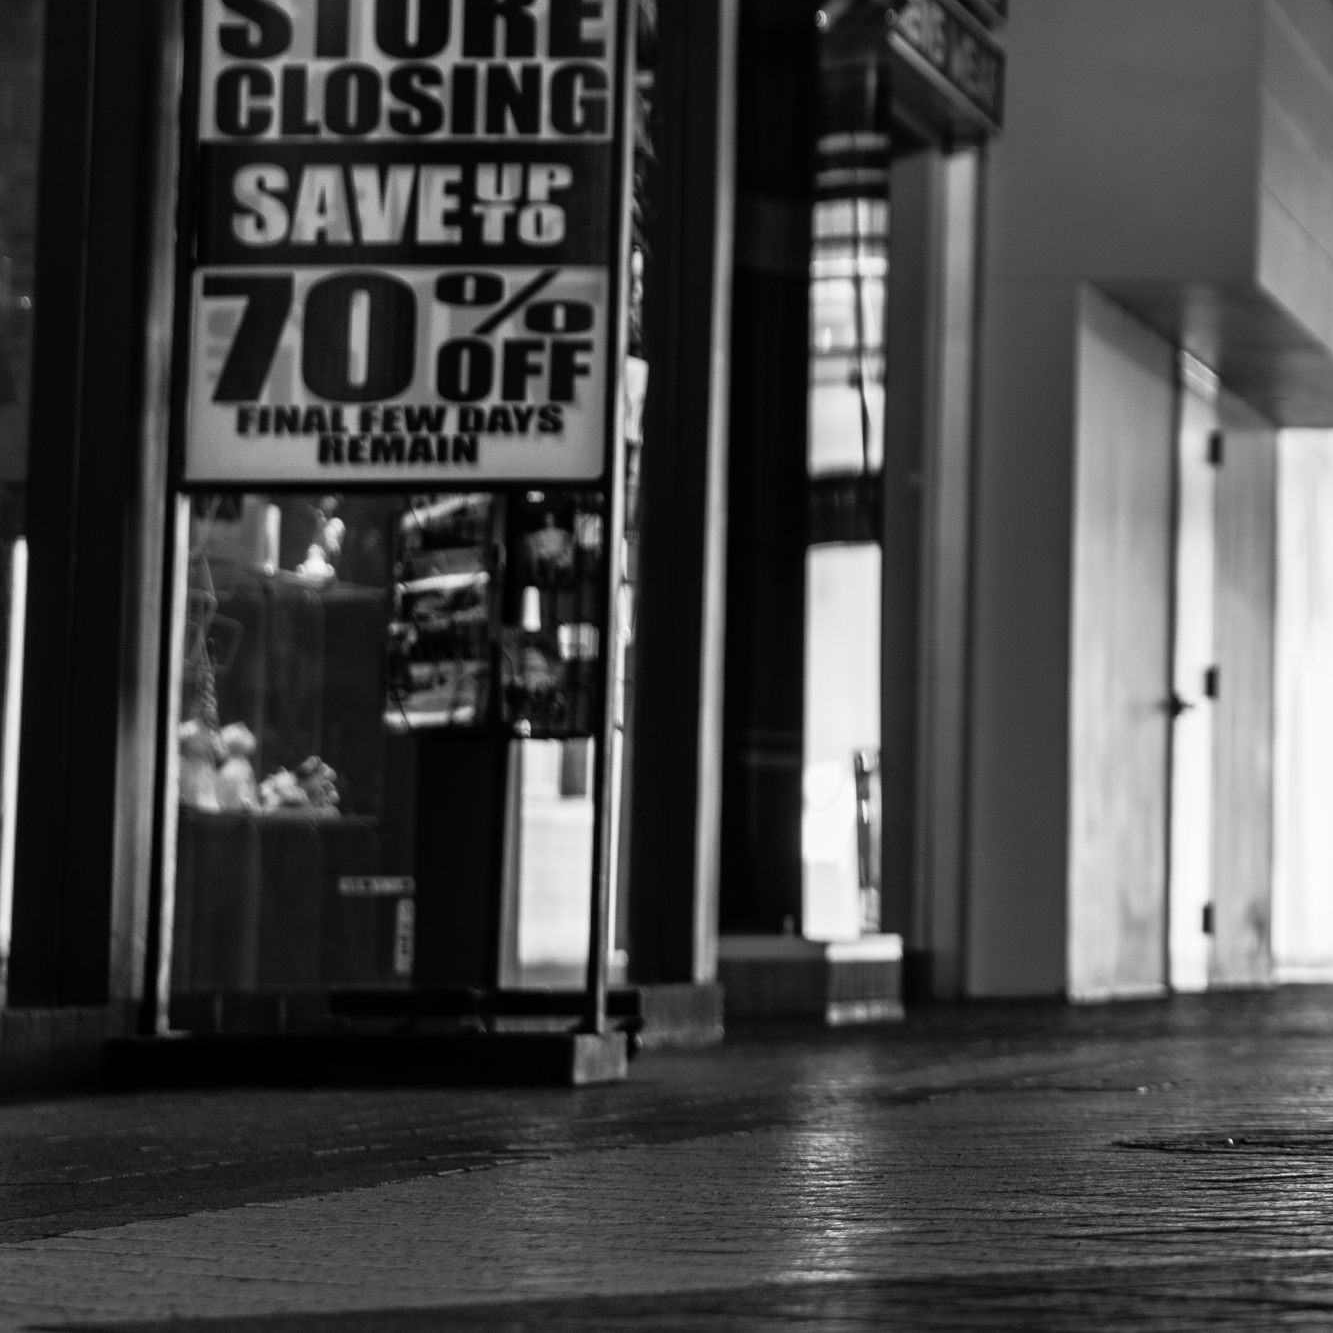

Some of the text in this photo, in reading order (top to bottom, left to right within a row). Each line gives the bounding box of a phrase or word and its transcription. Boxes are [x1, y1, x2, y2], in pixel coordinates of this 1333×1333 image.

[214, 61, 609, 138] CLOSING
[231, 161, 573, 246] SAVE UP TO
[202, 268, 595, 403] 70% OFF
[236, 404, 565, 436] FINAL FEW DAYS
[318, 434, 480, 465] REMAIN
